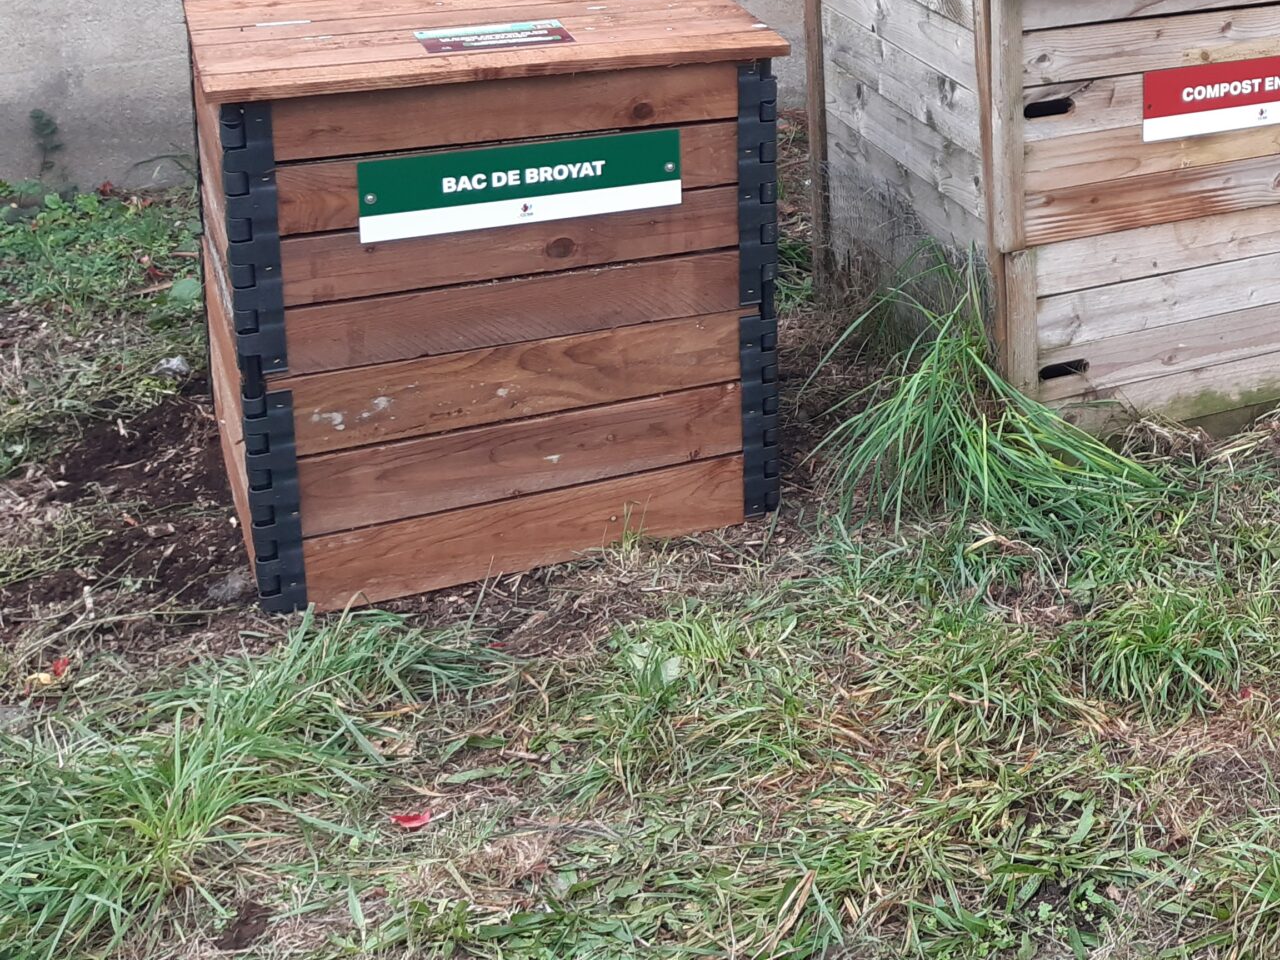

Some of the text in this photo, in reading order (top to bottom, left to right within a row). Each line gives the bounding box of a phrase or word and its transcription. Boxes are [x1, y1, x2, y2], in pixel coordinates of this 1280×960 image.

[1182, 78, 1262, 102] COMPOST
[442, 160, 606, 193] BAC DE BROYAT
